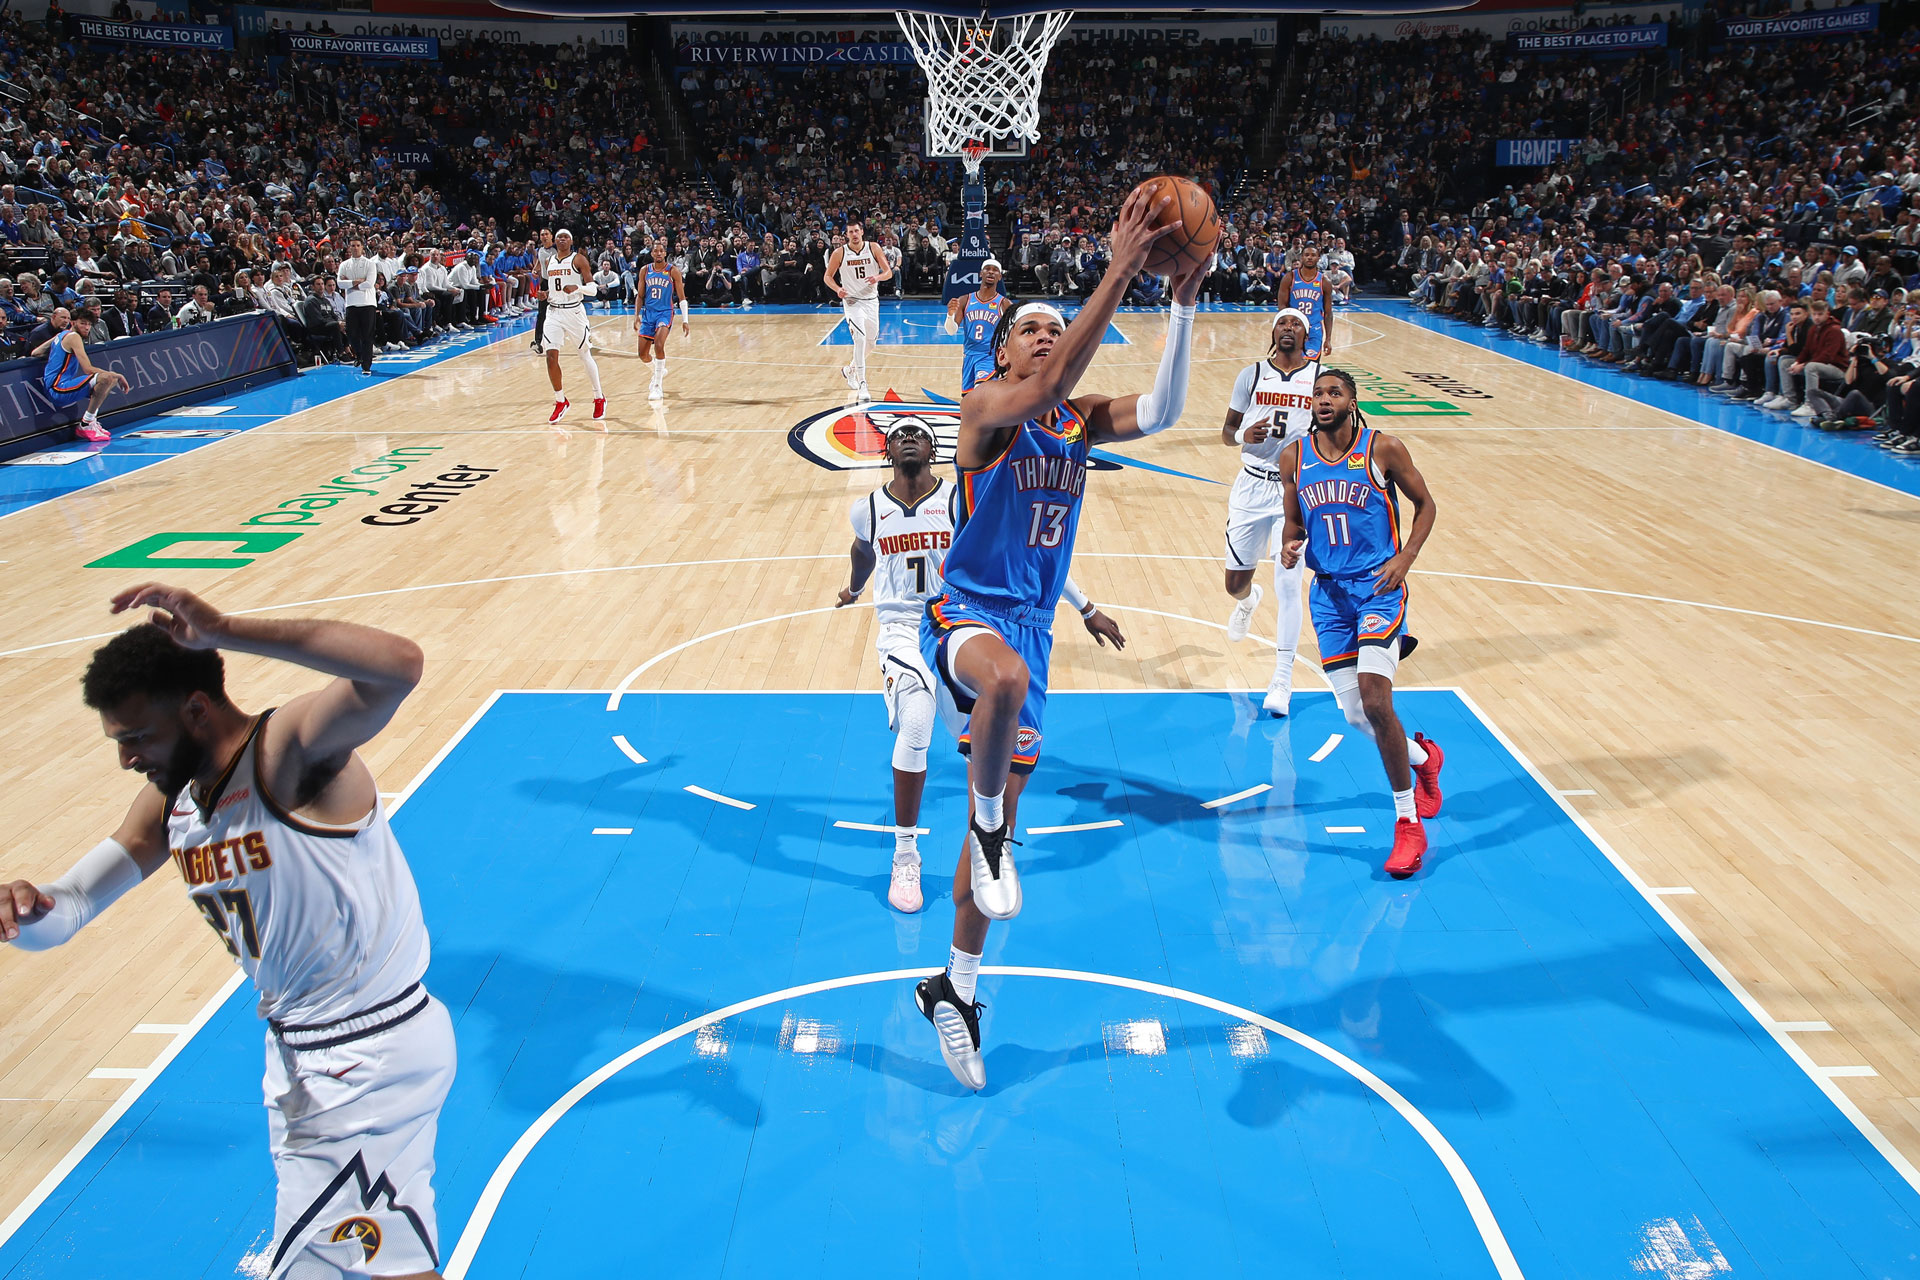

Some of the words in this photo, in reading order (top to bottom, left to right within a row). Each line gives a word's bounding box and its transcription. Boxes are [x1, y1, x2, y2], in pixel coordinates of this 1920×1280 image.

[1394, 20, 1432, 38] Bally
[1432, 23, 1460, 34] SPORTS
[1726, 22, 1762, 36] YOUR
[1765, 17, 1824, 33] FAVORITE
[1826, 11, 1870, 28] GAMES!
[80, 22, 103, 37] THE
[105, 24, 131, 39] BEST
[133, 27, 170, 42] PLACE
[173, 30, 190, 42] TO
[196, 32, 223, 45] PLAY
[600, 29, 625, 43] 119
[1071, 28, 1200, 44] THUNDER
[1252, 27, 1275, 42] 101
[1518, 37, 1541, 49] THE
[1544, 35, 1572, 47] BEST
[1575, 33, 1611, 45] PLACE
[1613, 32, 1629, 43] TO
[1631, 30, 1659, 43] PLAY
[290, 36, 323, 50] YOUR
[325, 39, 380, 53] FAVORITE
[383, 41, 429, 54] GAMES!
[691, 46, 824, 63] RIVERWIND
[970, 235, 980, 248] OU
[961, 247, 988, 257] Health
[854, 266, 866, 279] 15
[554, 277, 562, 291] 8
[646, 276, 670, 289] THUNDER
[651, 287, 662, 299] 21
[1292, 288, 1321, 301] THUNDER
[1298, 301, 1313, 315] 22
[965, 309, 999, 326] THUNDER
[974, 324, 984, 340] 2
[1255, 391, 1312, 411] NUGGETS
[1272, 411, 1288, 439] 5
[240, 446, 445, 526] paycom
[360, 464, 500, 527] center
[1299, 479, 1371, 511] THUNDER
[923, 508, 946, 516] ibotta
[1027, 501, 1071, 549] 13
[1321, 512, 1352, 546] 11
[878, 530, 951, 556] NUGGETS
[906, 556, 926, 594] 7
[192, 889, 262, 960] 27
